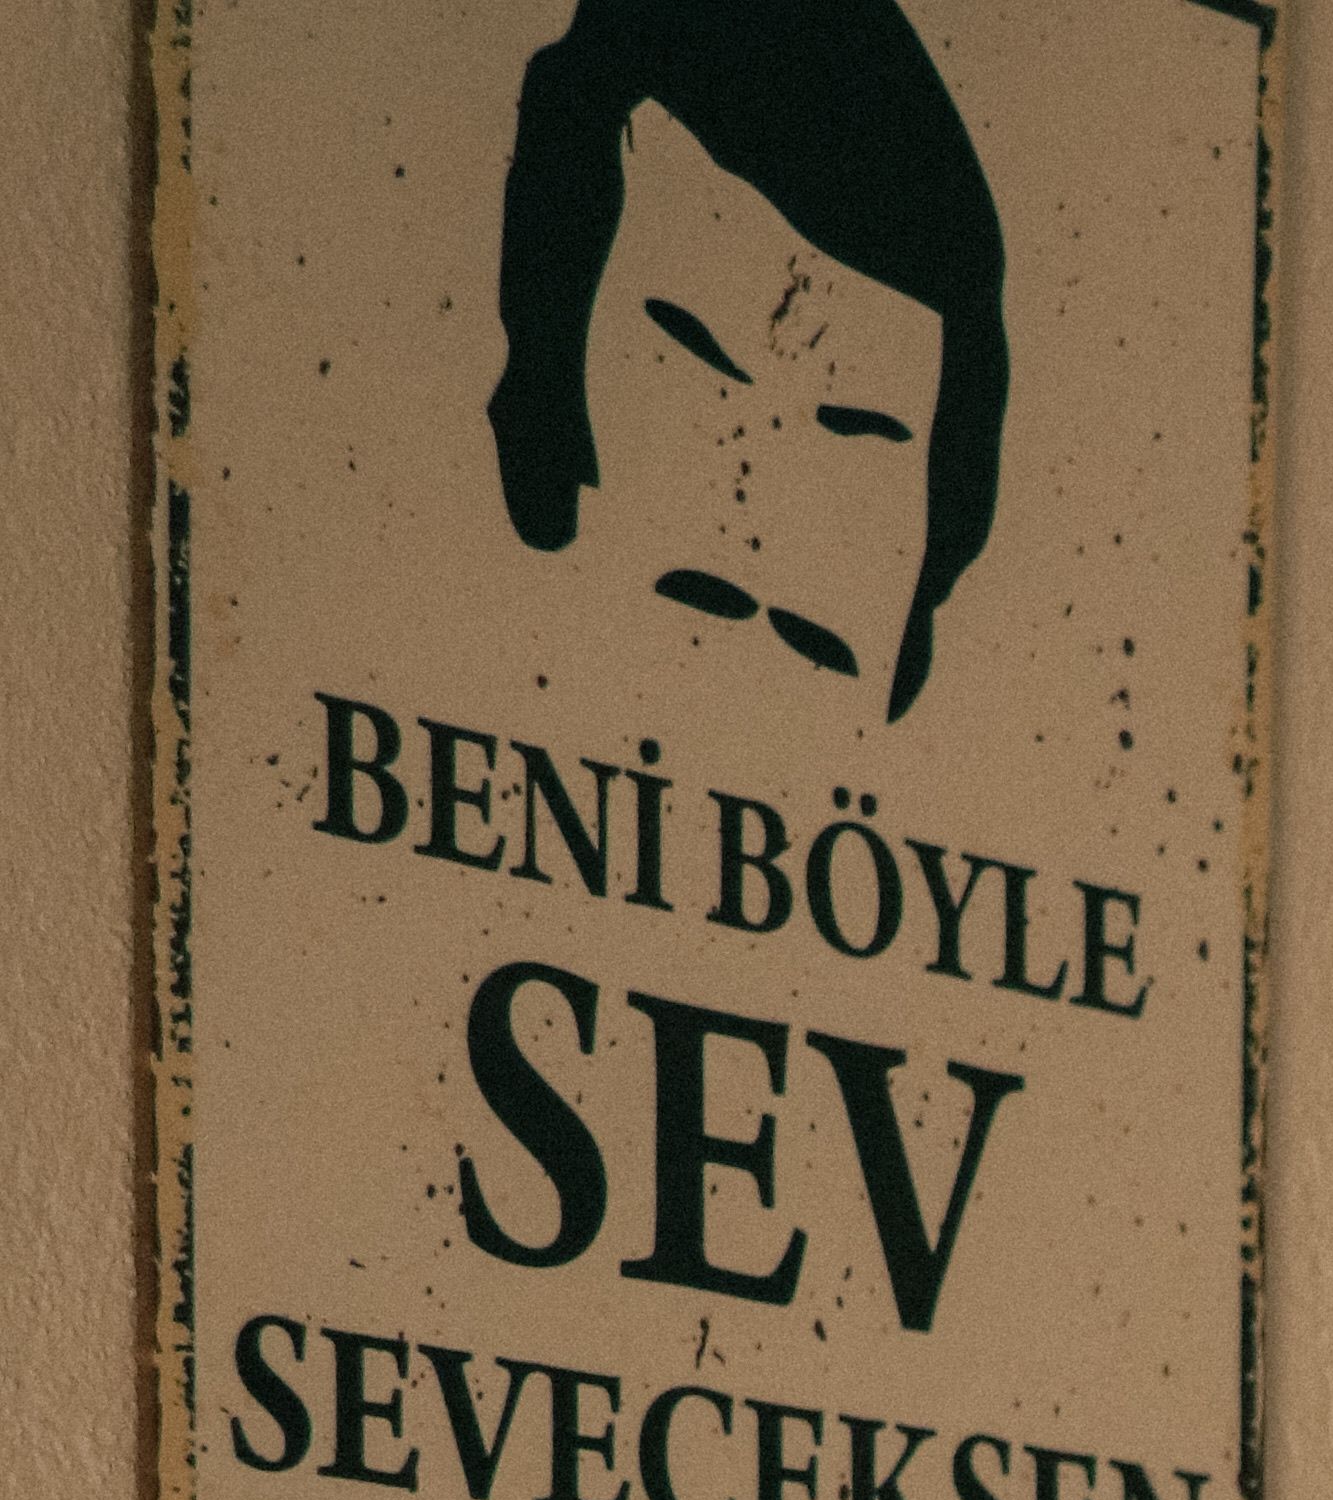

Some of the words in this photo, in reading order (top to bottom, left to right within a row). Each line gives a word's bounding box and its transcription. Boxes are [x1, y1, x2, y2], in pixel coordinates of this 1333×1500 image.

[313, 691, 675, 912] BENİ
[706, 786, 1149, 1019] BÖYLE
[456, 959, 1025, 1334] SEV
